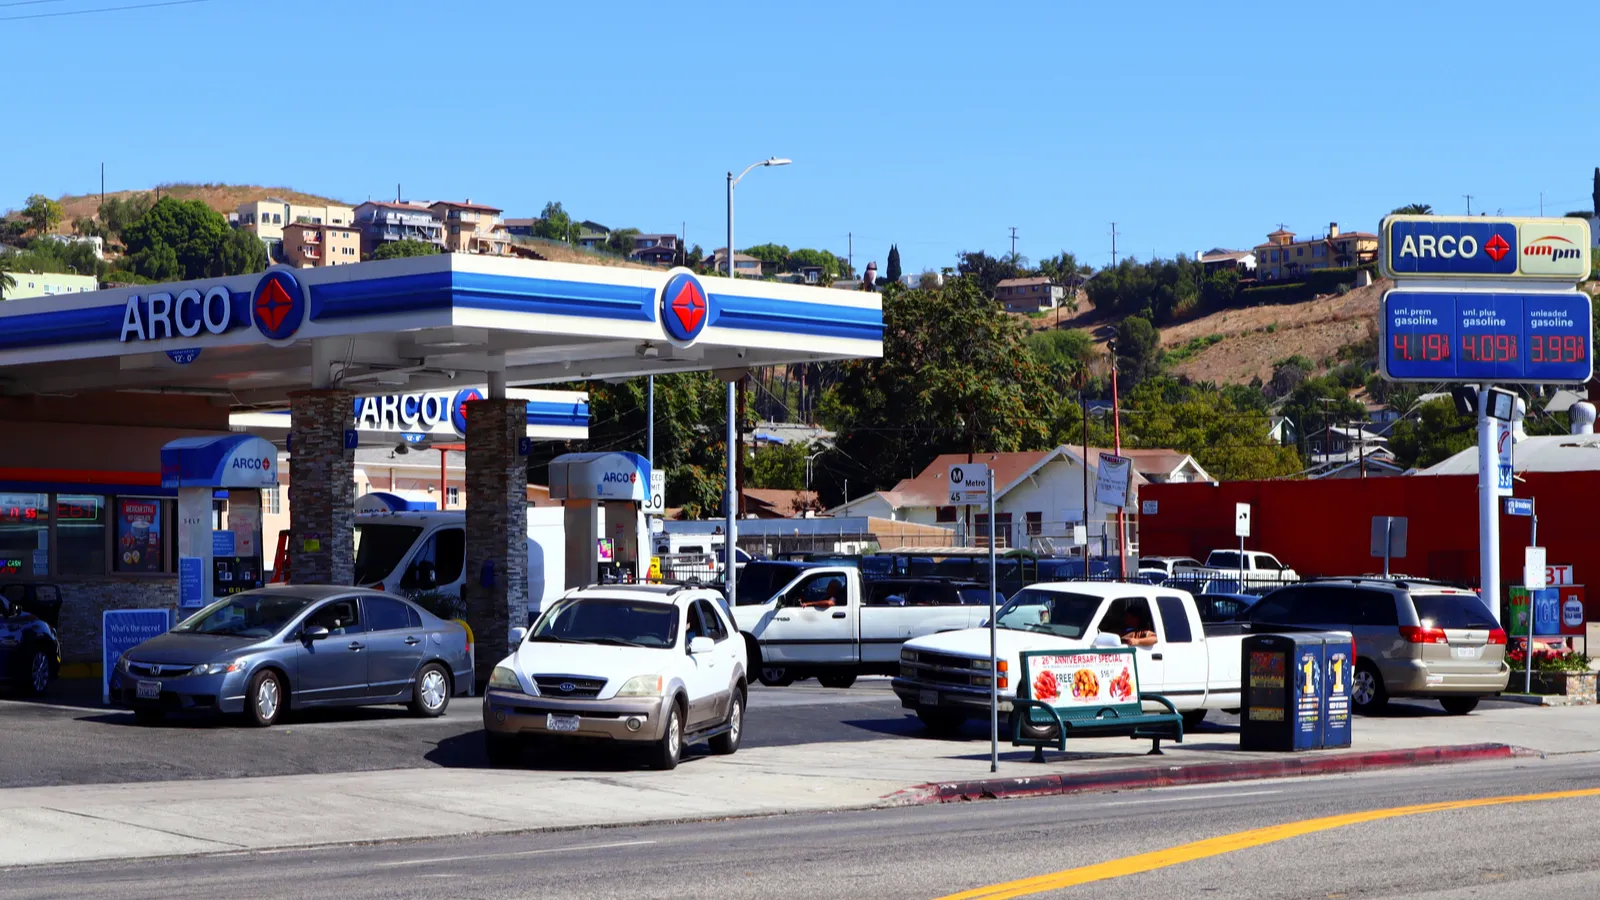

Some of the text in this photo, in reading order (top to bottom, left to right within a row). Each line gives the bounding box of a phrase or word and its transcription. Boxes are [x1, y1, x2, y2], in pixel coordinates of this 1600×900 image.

[1399, 235, 1478, 259] ARCO
[1523, 245, 1581, 262] ampm
[120, 285, 231, 342] ARCO
[1394, 308, 1431, 317] unl. prem
[1462, 308, 1496, 317] unl. plus
[1530, 309, 1567, 317] unleaded
[1394, 315, 1438, 328] gasoline
[1463, 316, 1506, 328] gasoline
[1531, 317, 1574, 329] gasoline
[1394, 334, 1441, 361] 4.19
[1462, 335, 1509, 361] 4.09
[1531, 336, 1577, 362] 3.99
[360, 392, 442, 428] ARCO
[348, 432, 354, 445] 7
[521, 440, 528, 451] 5
[232, 457, 262, 470] ARCO
[603, 471, 629, 484] ARCO
[651, 474, 662, 482] EED
[965, 479, 986, 487] Metro
[651, 483, 661, 491] MIT
[951, 492, 961, 502] 45
[125, 505, 143, 514] MEXICAN
[1546, 566, 1568, 585] BT
[1536, 600, 1559, 622] ICE
[110, 624, 160, 633] What's the secret
[123, 635, 138, 644] clean
[1054, 654, 1098, 665] ANNIVERSARY
[1098, 654, 1123, 664] SPECIAL
[1055, 672, 1074, 684] FREE!
[1303, 659, 1315, 694] 1
[1333, 658, 1344, 693] 1
